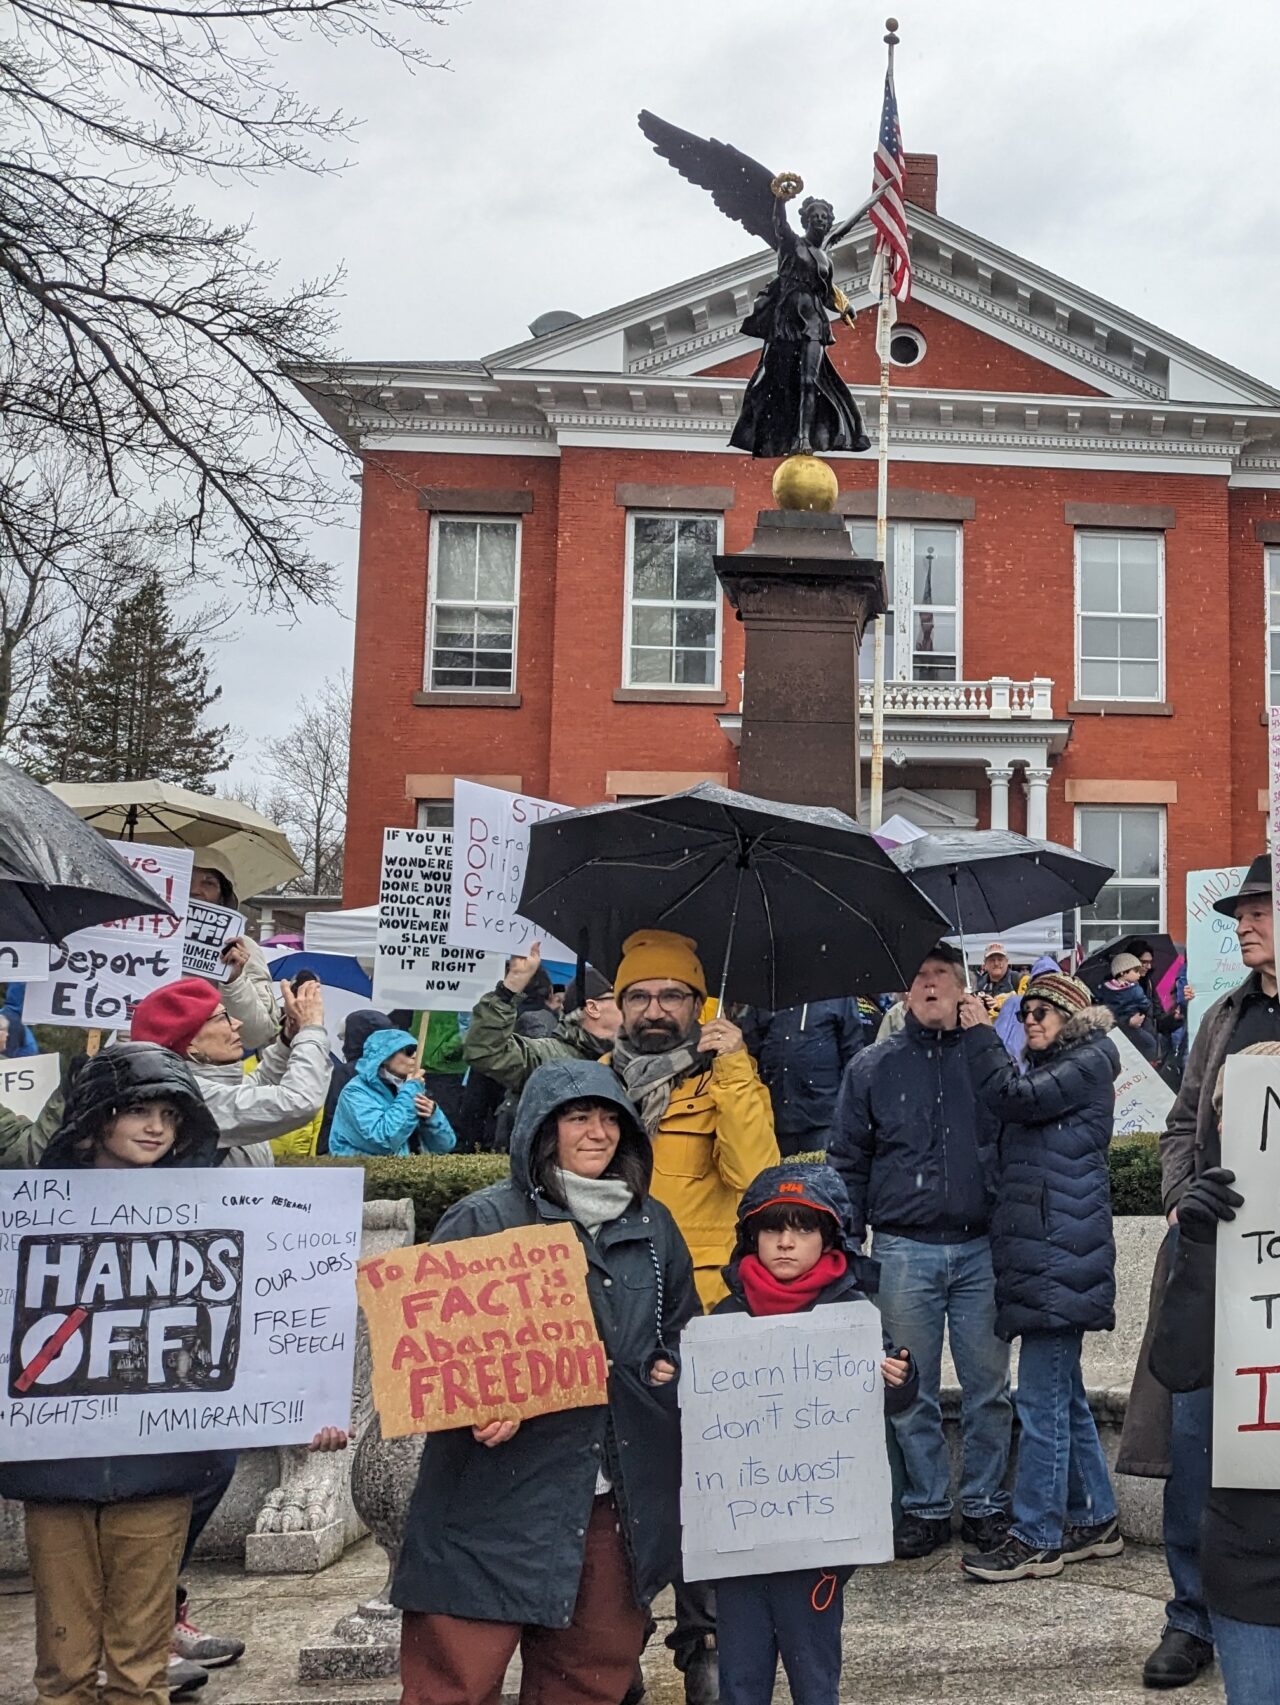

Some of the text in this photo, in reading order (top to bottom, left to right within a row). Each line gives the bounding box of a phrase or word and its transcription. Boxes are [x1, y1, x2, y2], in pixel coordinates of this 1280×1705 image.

[512, 799, 561, 822] ST
[386, 830, 400, 841] IF
[406, 832, 435, 844] YOU
[470, 817, 529, 850] Dera
[424, 845, 453, 856] EVE
[385, 856, 453, 870] WONDERE
[468, 844, 520, 881] Olig
[385, 868, 451, 882] YOU WOU
[382, 881, 452, 894] DONE DUR
[464, 872, 518, 904] Grab
[1189, 869, 1241, 922] HANDS
[381, 893, 451, 907] HOLOCAUS
[381, 906, 420, 918] CIVIL
[187, 920, 225, 945] FF!
[379, 919, 449, 932] MOVEMEN
[1212, 919, 1237, 933] Our
[401, 933, 447, 945] SLAVE
[50, 942, 171, 981] Deport
[379, 944, 485, 960] YOU'RE DOING
[182, 956, 216, 972] CTIONS
[400, 959, 476, 973] IT RIGHT
[425, 979, 460, 991] NOW
[13, 1179, 70, 1200] AIR!
[779, 1183, 804, 1193] HH
[1, 1204, 198, 1228] UBLIC LANDS!
[267, 1232, 356, 1251] SCHOOLS!
[25, 1238, 239, 1308] HANDS
[255, 1253, 352, 1296] OUR JOBS
[359, 1242, 570, 1289] To Abandon
[402, 1267, 567, 1329] FACT is
[540, 1286, 575, 1307] to
[254, 1307, 331, 1334] FREE
[269, 1333, 344, 1354] SPEECH
[392, 1317, 593, 1370] Abandon
[692, 1344, 875, 1394] Learn History
[410, 1343, 605, 1418] FREEDOM
[10, 1397, 304, 1436] RIGHTS!!! IMMIGRANTS!!!
[702, 1397, 860, 1440] don't star
[695, 1450, 854, 1491] in its worst
